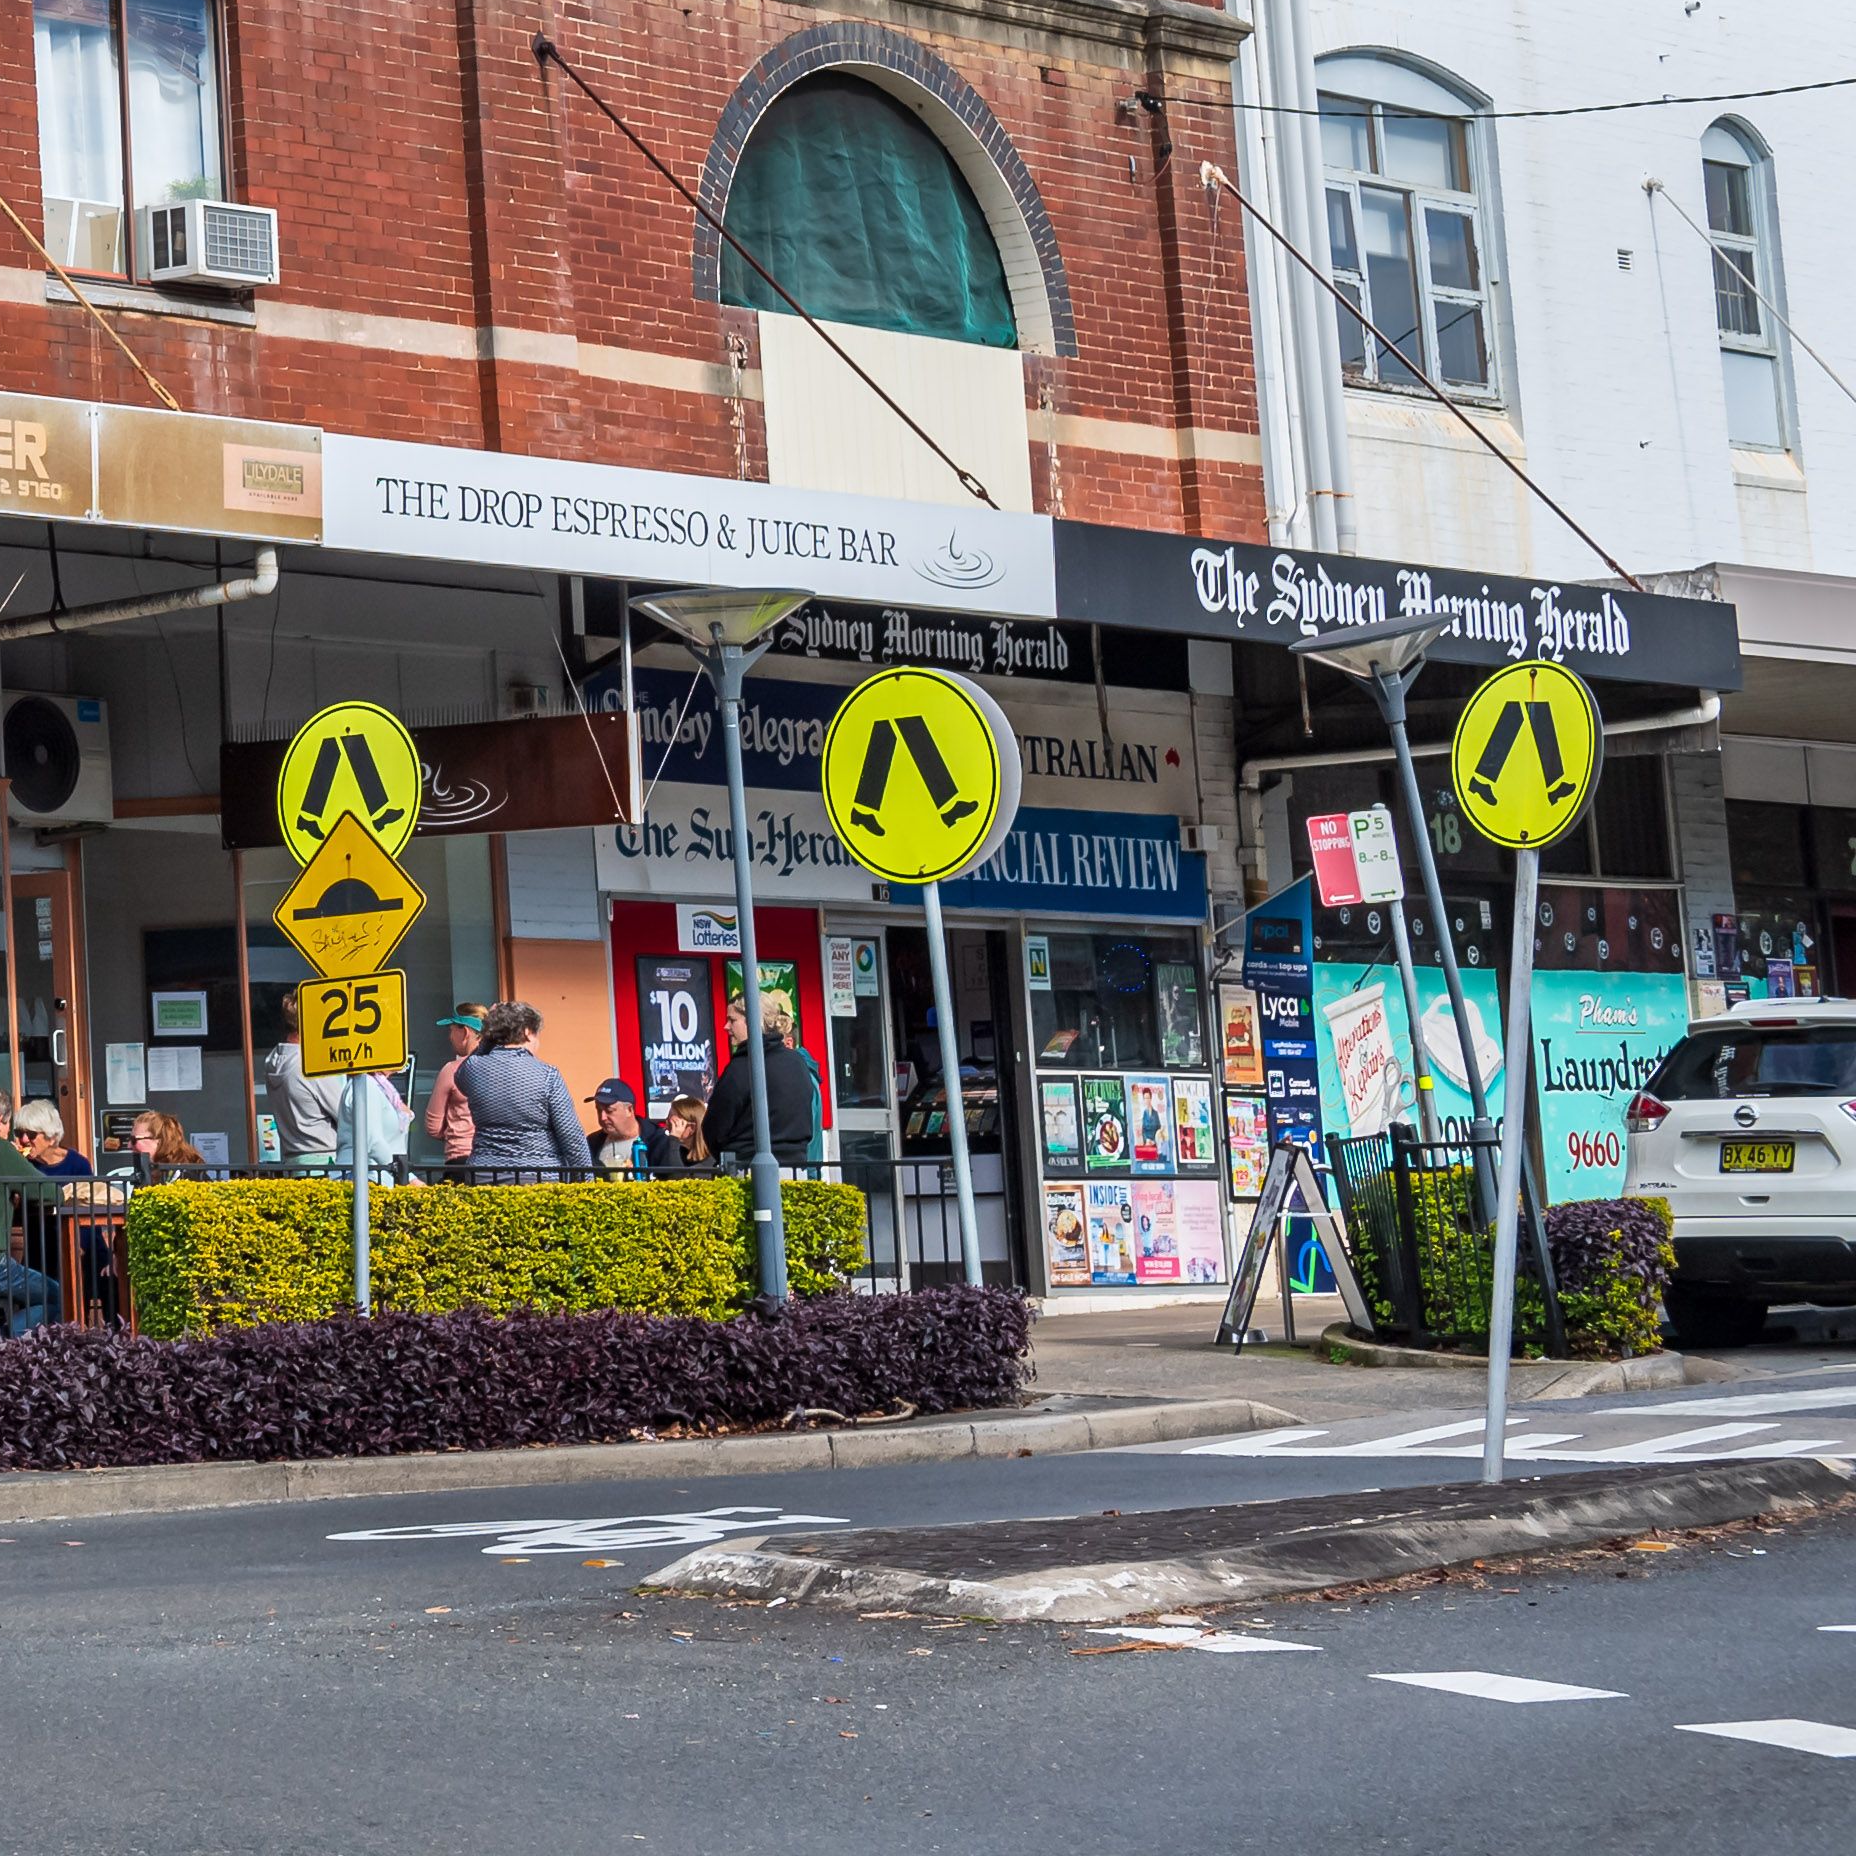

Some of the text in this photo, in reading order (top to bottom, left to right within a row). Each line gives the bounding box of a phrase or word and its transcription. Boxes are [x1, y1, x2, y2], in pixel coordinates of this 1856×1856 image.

[244, 462, 302, 484] LILYDALE
[18, 479, 63, 500] 9760
[249, 491, 281, 500] AVAILABLE
[376, 476, 900, 568] THE DROP ESPRESSO & JUICE BAR
[1190, 546, 1260, 629] The
[1266, 552, 1387, 637] Sydney
[1531, 585, 1630, 664] Herald
[780, 608, 1070, 677] Sydney Morning Herald
[615, 809, 681, 859] The
[1320, 820, 1337, 835] NO
[1353, 817, 1385, 840] P 5
[1430, 812, 1462, 855] 18
[1312, 836, 1351, 852] STOPPING
[1072, 833, 1181, 892] REVIEW
[879, 884, 890, 901] 16
[692, 917, 712, 930] NSW
[692, 927, 739, 948] Lotteries
[832, 950, 851, 962] ANY
[832, 973, 851, 982] RIGHT
[1246, 961, 1268, 969] cards
[1278, 962, 1292, 972] top
[1292, 963, 1308, 974] ups
[320, 984, 382, 1040] 25
[1261, 992, 1300, 1022] Lyca
[1578, 994, 1638, 1029] Pham's
[1279, 1016, 1301, 1028] Mobile
[329, 1042, 373, 1063] km/h
[652, 1042, 705, 1060] MILLION
[1568, 1130, 1621, 1171] 9660
[1723, 1145, 1791, 1164] BX 46 YY
[1089, 1184, 1119, 1206] INSIDE
[1639, 1180, 1678, 1190] X-TRAIL
